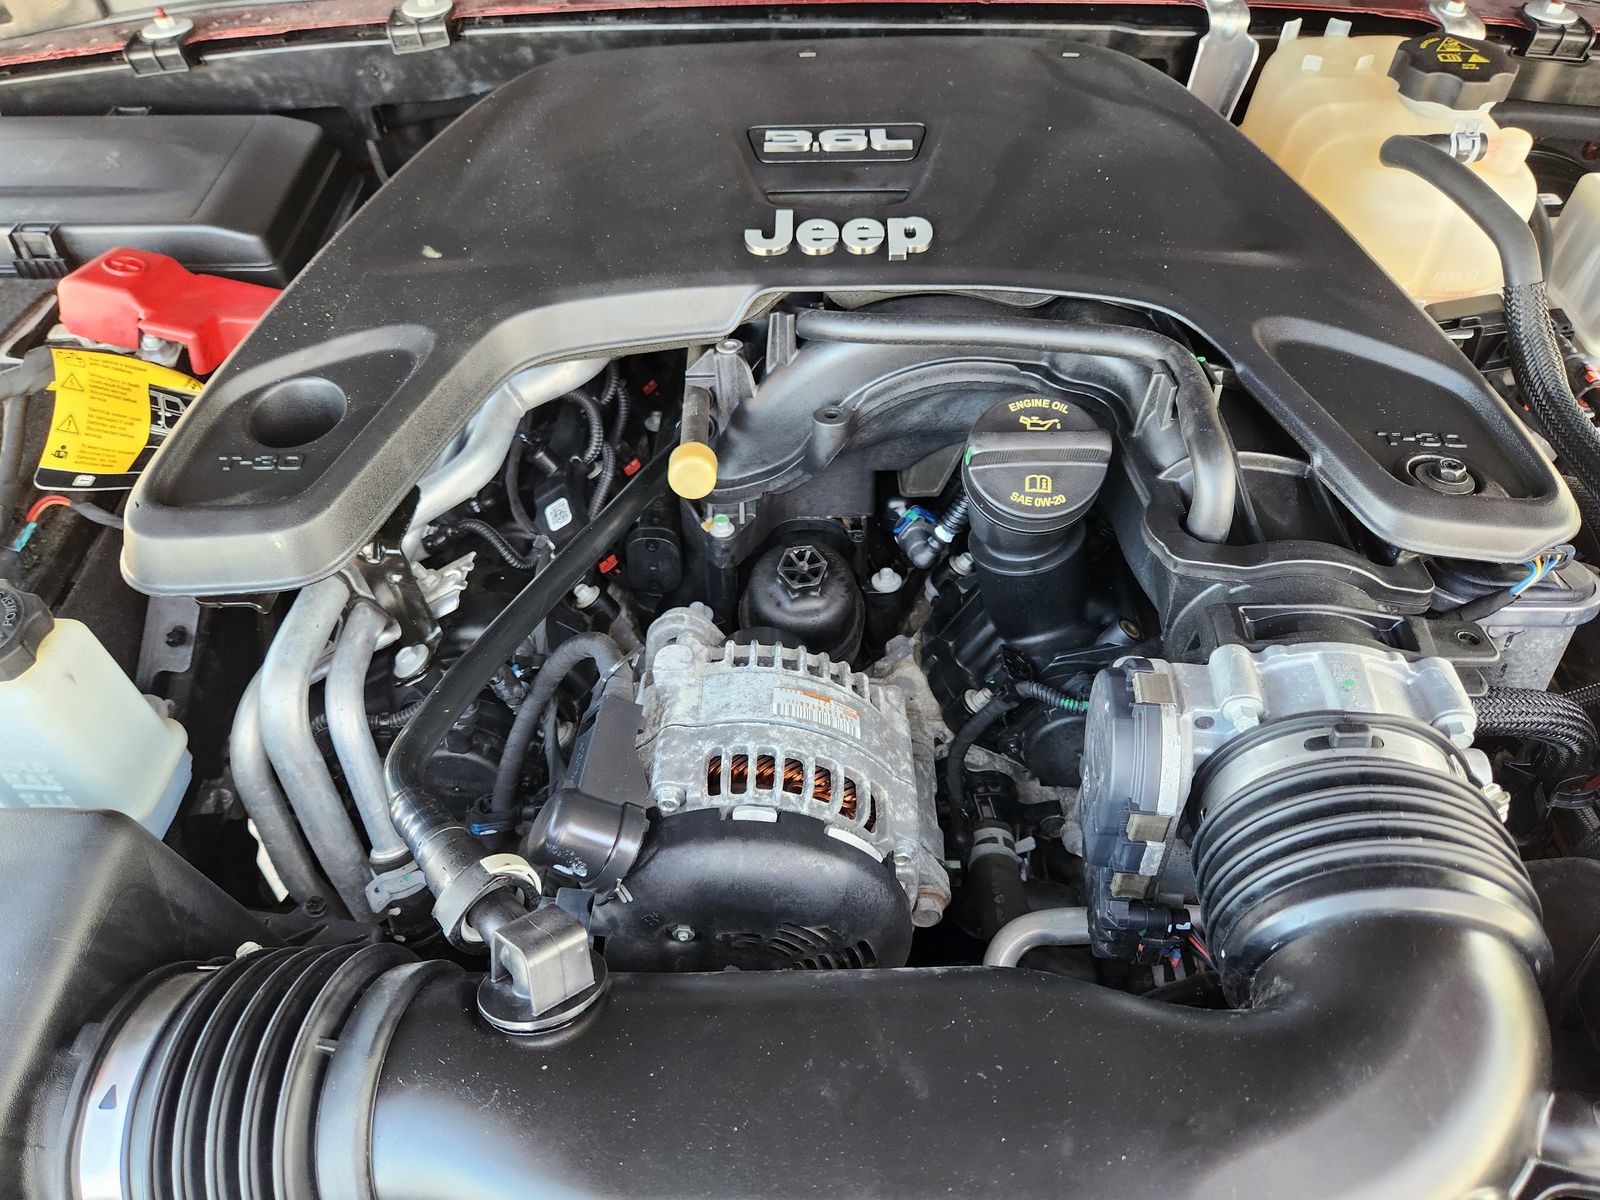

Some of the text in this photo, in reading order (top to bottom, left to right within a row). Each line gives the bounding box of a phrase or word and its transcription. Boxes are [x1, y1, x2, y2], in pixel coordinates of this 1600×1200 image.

[763, 128, 914, 153] 3.6L
[744, 208, 934, 262] Jeep
[1008, 399, 1069, 414] ENGINE OIL
[1010, 492, 1066, 507] SAE 0W-20
